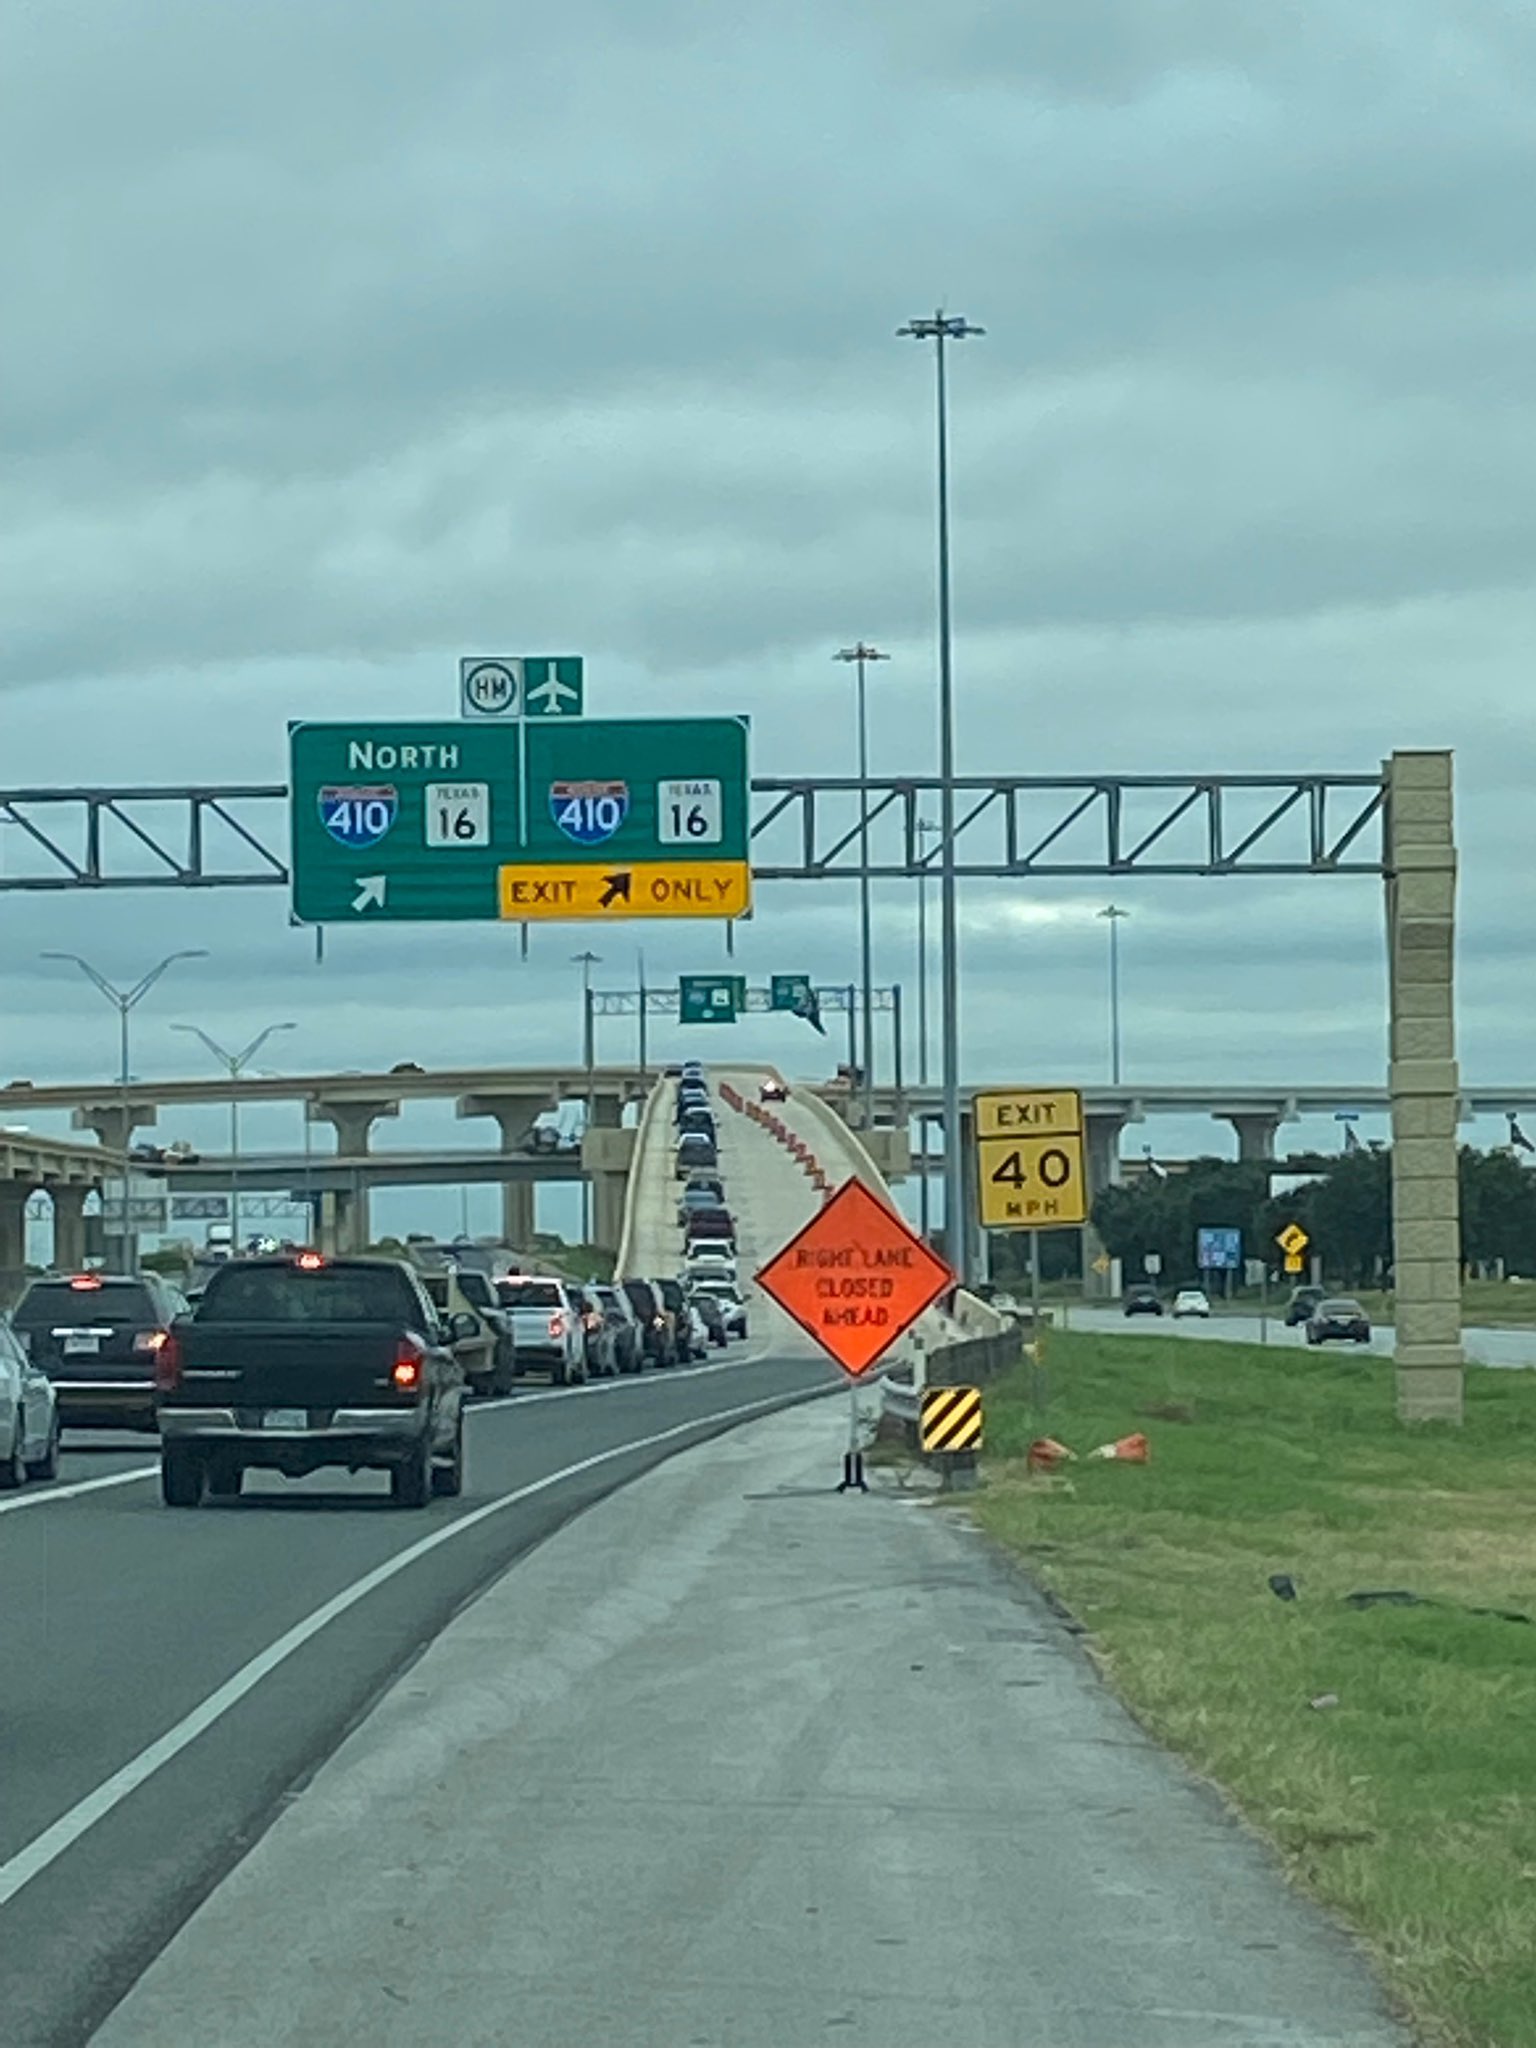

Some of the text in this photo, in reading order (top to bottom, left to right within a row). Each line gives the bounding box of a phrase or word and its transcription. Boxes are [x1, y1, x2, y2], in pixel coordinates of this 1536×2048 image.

[477, 678, 508, 699] HM
[348, 740, 459, 770] NORTH
[436, 787, 480, 799] TEXAS
[327, 801, 389, 835] 410
[439, 806, 476, 840] 16
[559, 798, 620, 832] 410
[671, 804, 708, 837] 16
[511, 878, 734, 904] EXIT ONLY
[997, 1102, 1057, 1126] EXIT
[992, 1148, 1071, 1190] 40
[1006, 1199, 1059, 1217] MPH
[796, 1247, 913, 1269] RIGHT LANE
[815, 1278, 894, 1299] CLOSED
[822, 1306, 889, 1327] AHEAD
